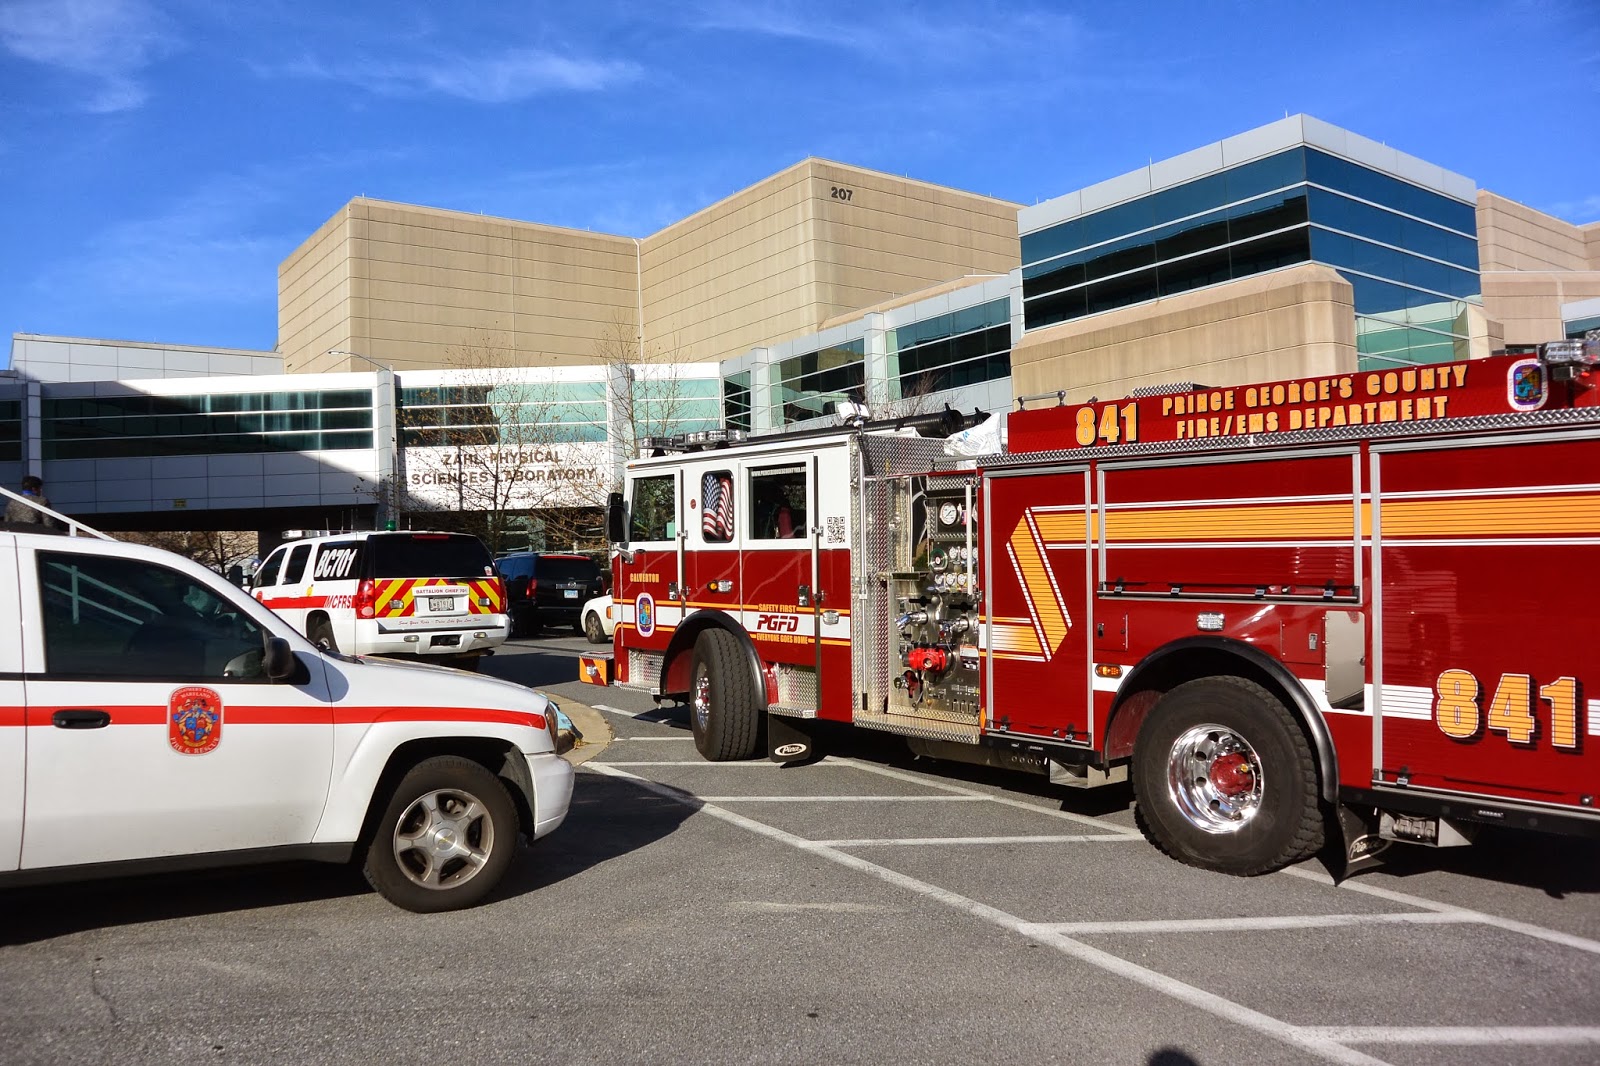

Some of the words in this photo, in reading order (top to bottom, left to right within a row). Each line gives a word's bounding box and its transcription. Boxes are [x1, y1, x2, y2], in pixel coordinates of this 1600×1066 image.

[831, 186, 853, 201] 207
[1162, 391, 1235, 416] PRINCE
[1245, 377, 1353, 407] GEORGE'S
[1366, 365, 1468, 396] COUNTY
[1076, 402, 1138, 446] 841
[1176, 411, 1279, 439] FIRE/EMS
[1289, 395, 1449, 430] DEPARTMENT
[490, 450, 563, 465] PHYSICAL
[411, 471, 489, 485] SCIENCES
[314, 548, 358, 578] BC701
[629, 572, 660, 583] CALVERTON
[324, 595, 352, 609] MCFRS
[758, 603, 779, 612] SAFETY
[779, 604, 797, 613] FIRST
[757, 614, 799, 632] PGFD
[756, 632, 780, 642] EVERYONE
[780, 634, 793, 644] GOES
[793, 636, 808, 645] HOME
[1437, 669, 1579, 750] 841
